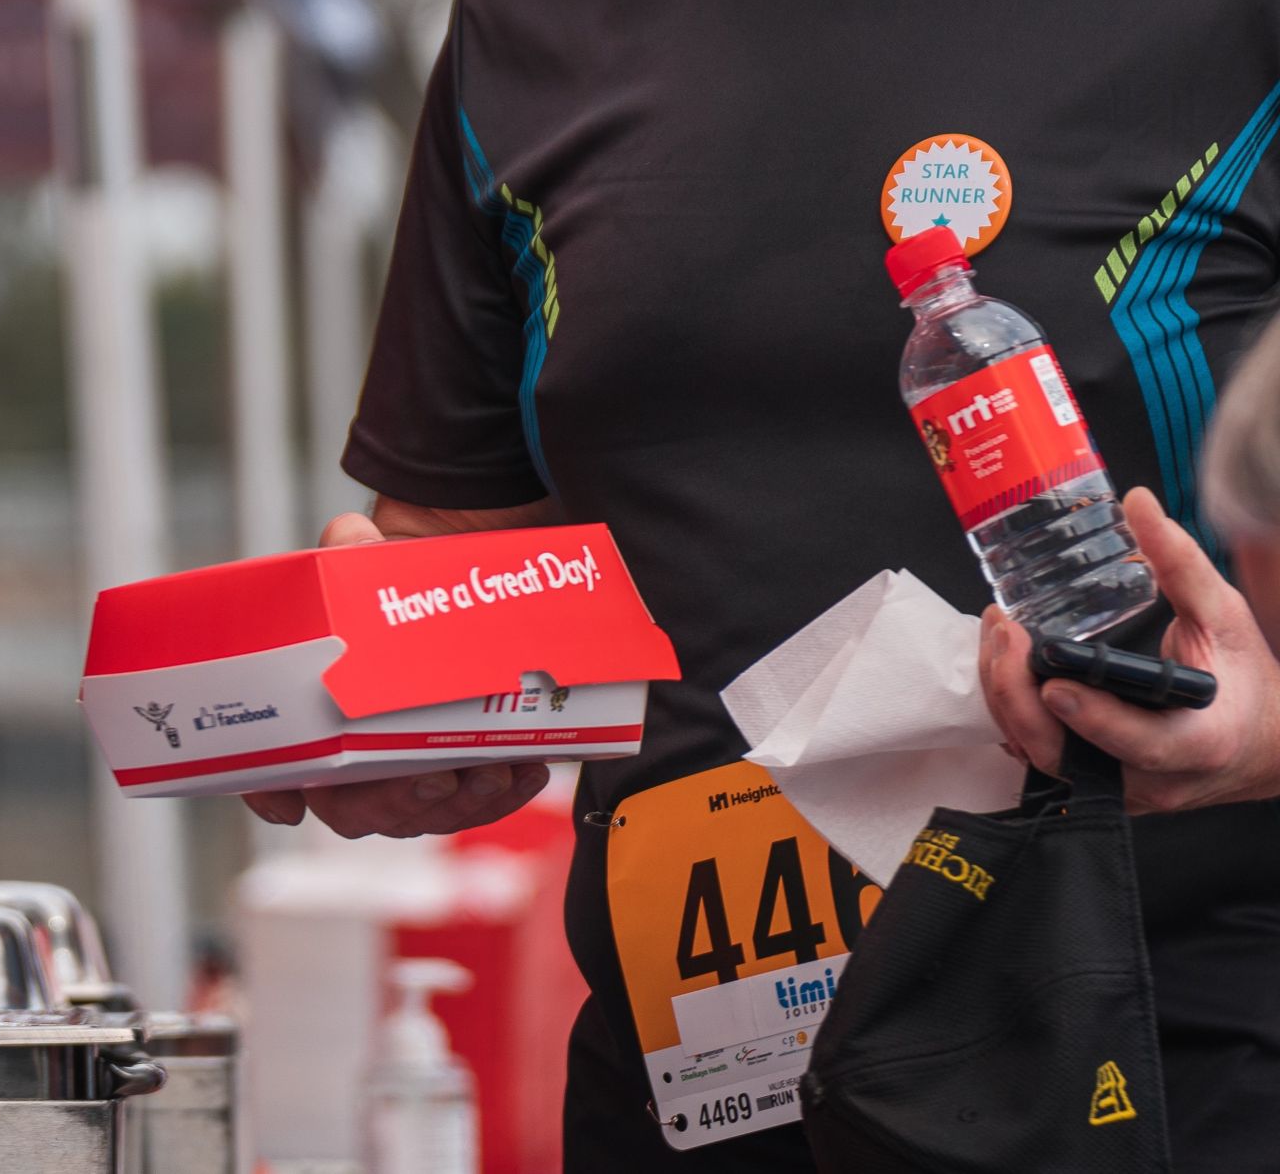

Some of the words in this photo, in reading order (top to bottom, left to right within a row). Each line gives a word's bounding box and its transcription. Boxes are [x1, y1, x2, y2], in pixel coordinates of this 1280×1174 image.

[921, 162, 969, 180] STAR
[900, 186, 986, 205] RUNNER
[377, 586, 451, 626] Have
[452, 583, 475, 609] a
[470, 559, 544, 604] Great
[537, 545, 601, 592] Day!
[217, 704, 280, 726] facebook
[785, 1000, 832, 1020] SOLUT
[699, 1092, 752, 1130] 4469
[770, 1089, 794, 1107] RUN
